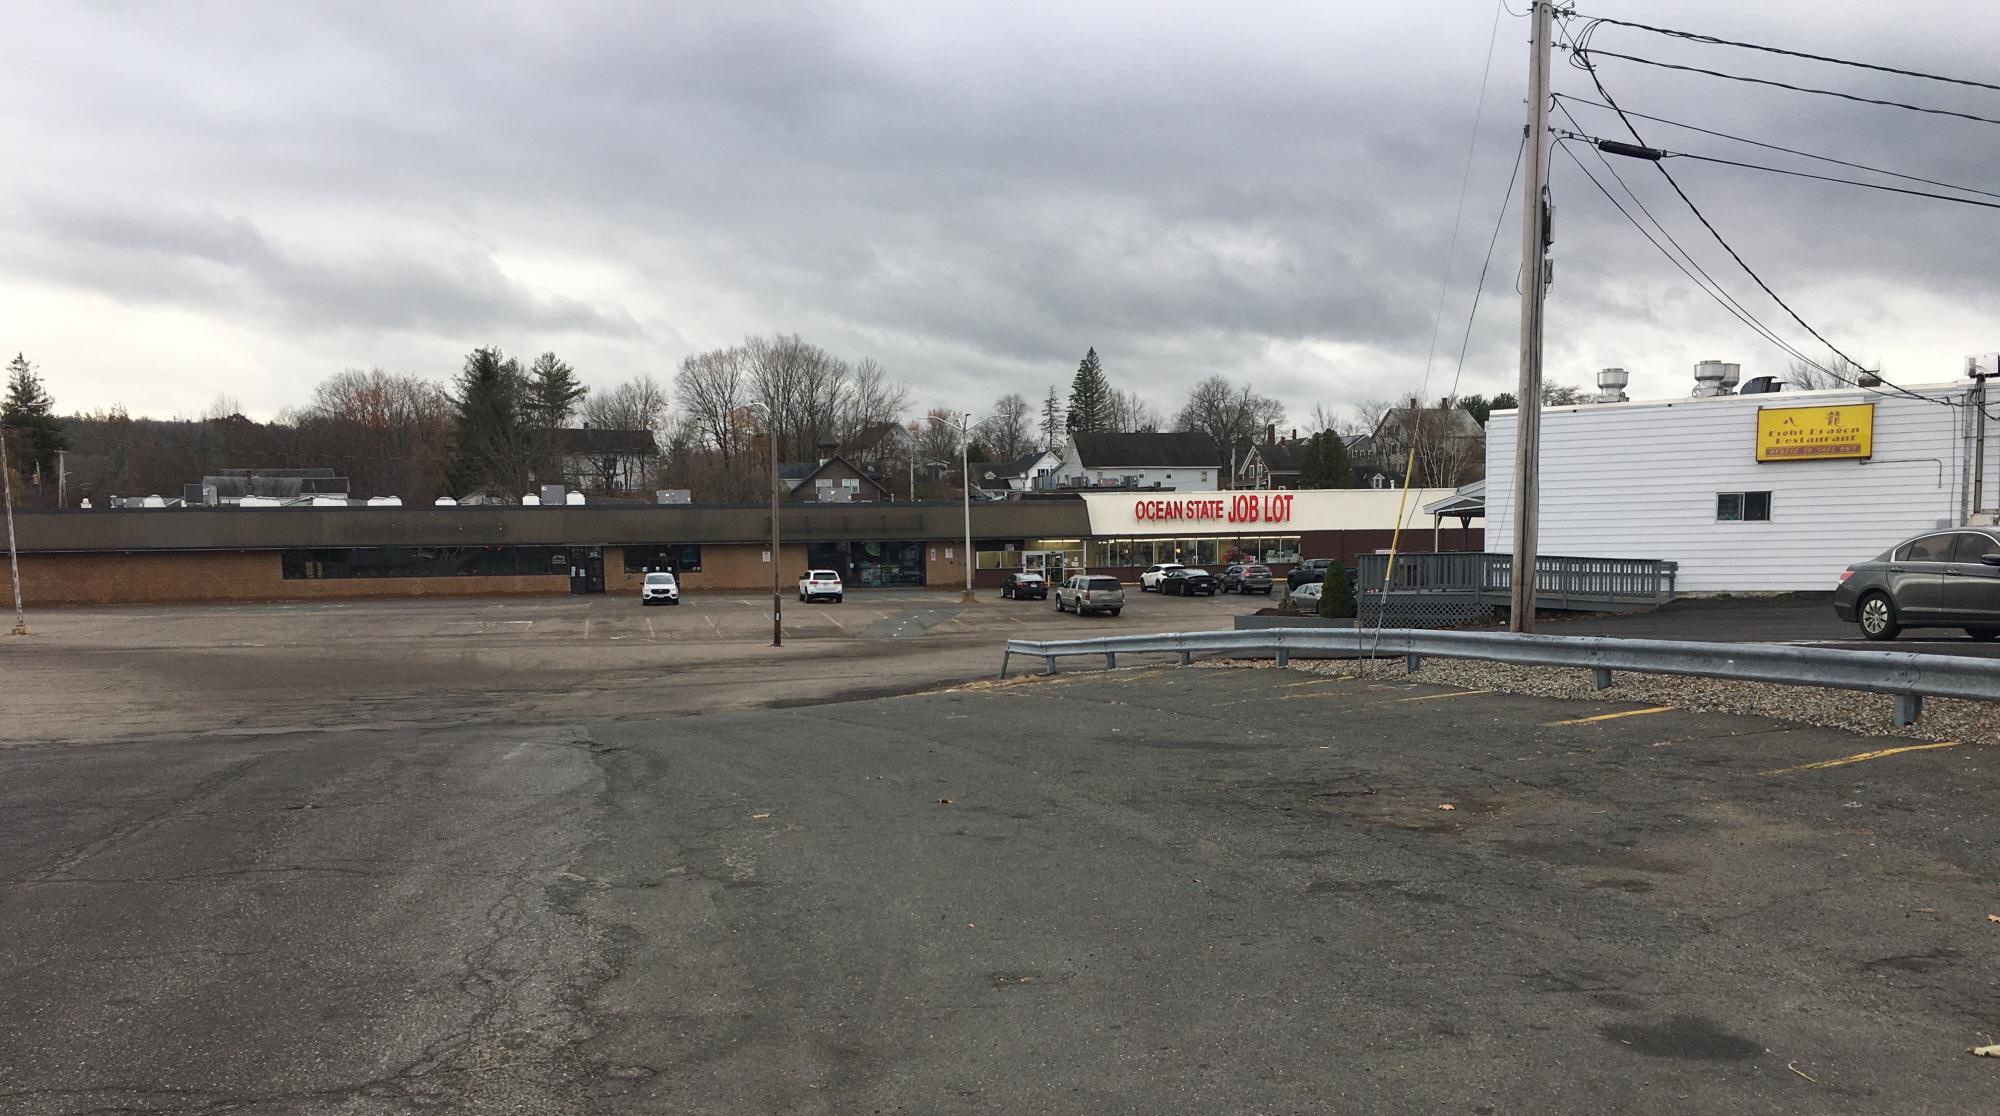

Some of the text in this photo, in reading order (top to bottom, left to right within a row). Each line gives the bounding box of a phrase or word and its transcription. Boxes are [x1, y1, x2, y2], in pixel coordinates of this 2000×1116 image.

[1135, 495, 1294, 523] OCEAN STATE JOB LOT
